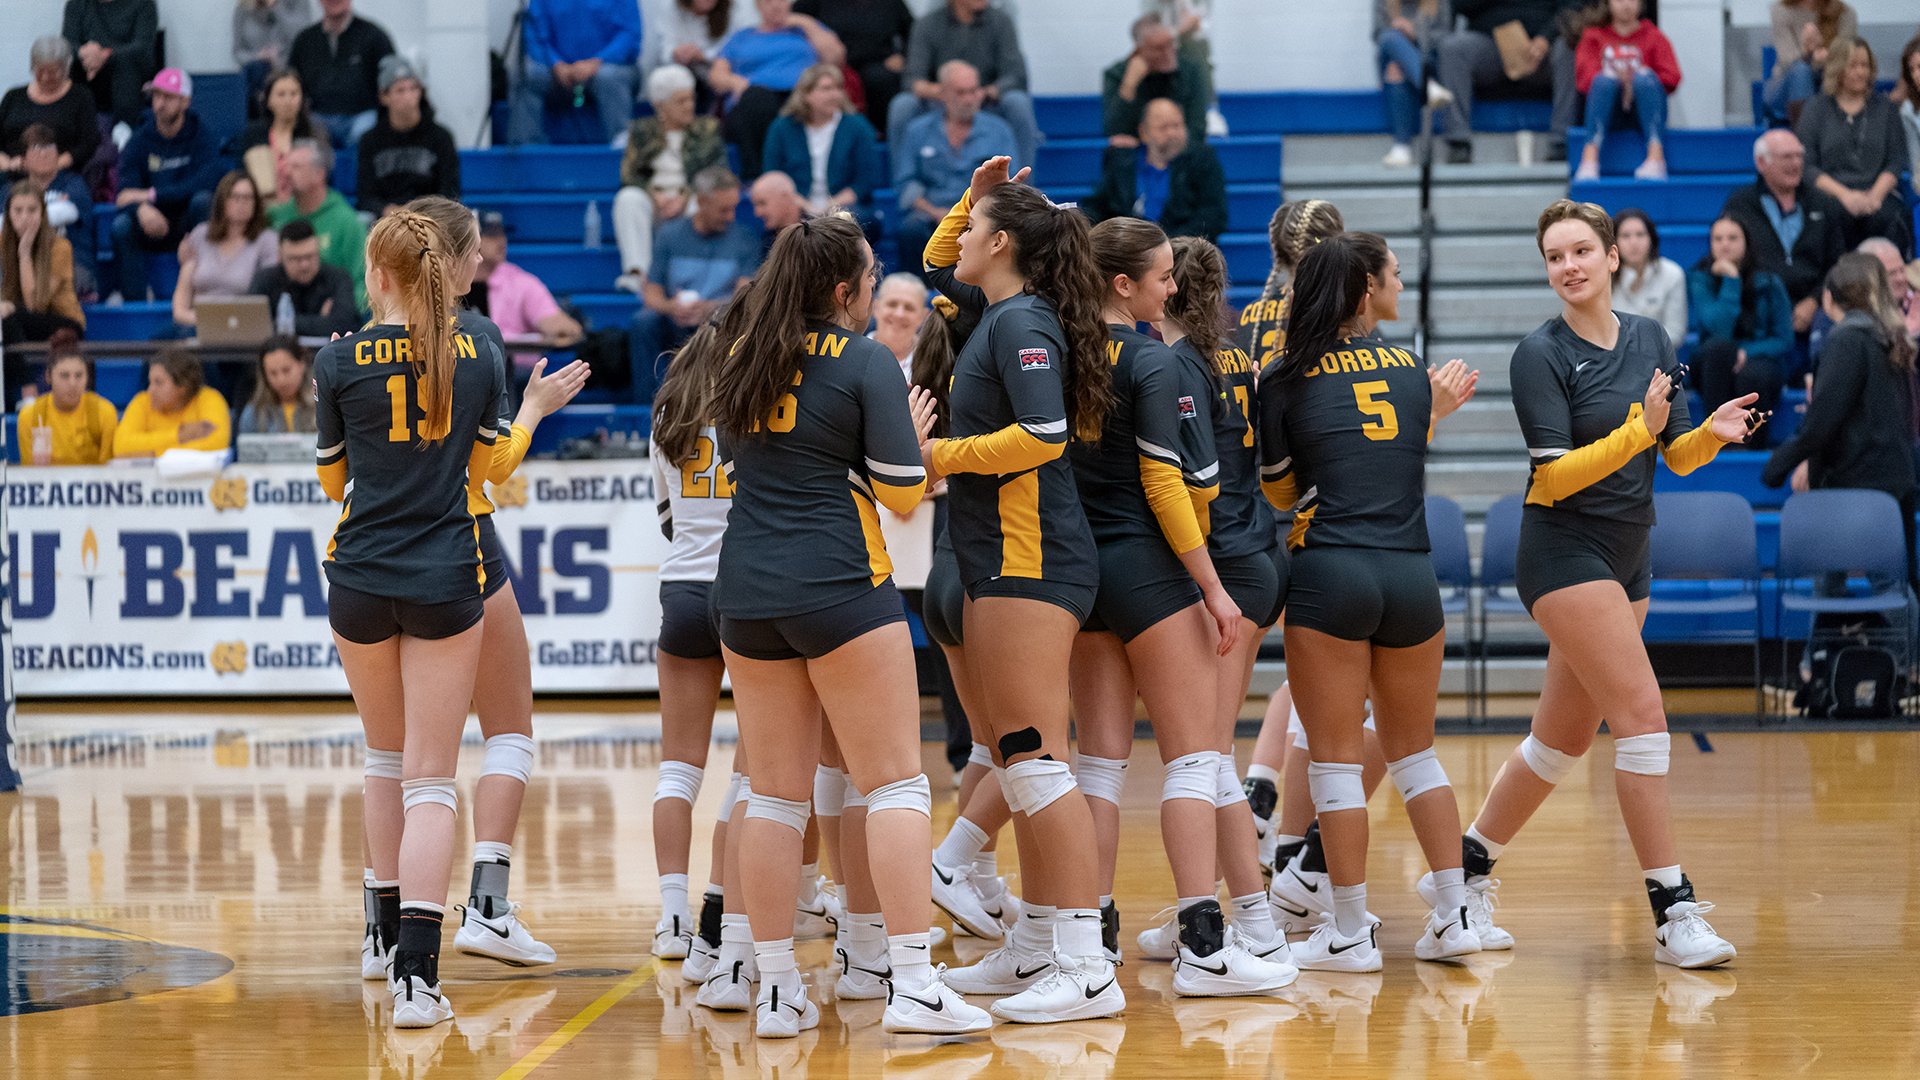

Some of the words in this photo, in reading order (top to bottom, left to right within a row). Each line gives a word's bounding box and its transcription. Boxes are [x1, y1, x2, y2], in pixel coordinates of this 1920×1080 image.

[355, 334, 478, 366] CORN
[1021, 354, 1047, 364] CCC
[386, 374, 453, 442] 19
[1232, 385, 1255, 448] 7
[1352, 380, 1399, 441] 5
[8, 480, 204, 508] BEACONS.com
[253, 478, 332, 505] GoBE
[118, 526, 610, 619] BEANS
[12, 644, 205, 670] BEACONS.com
